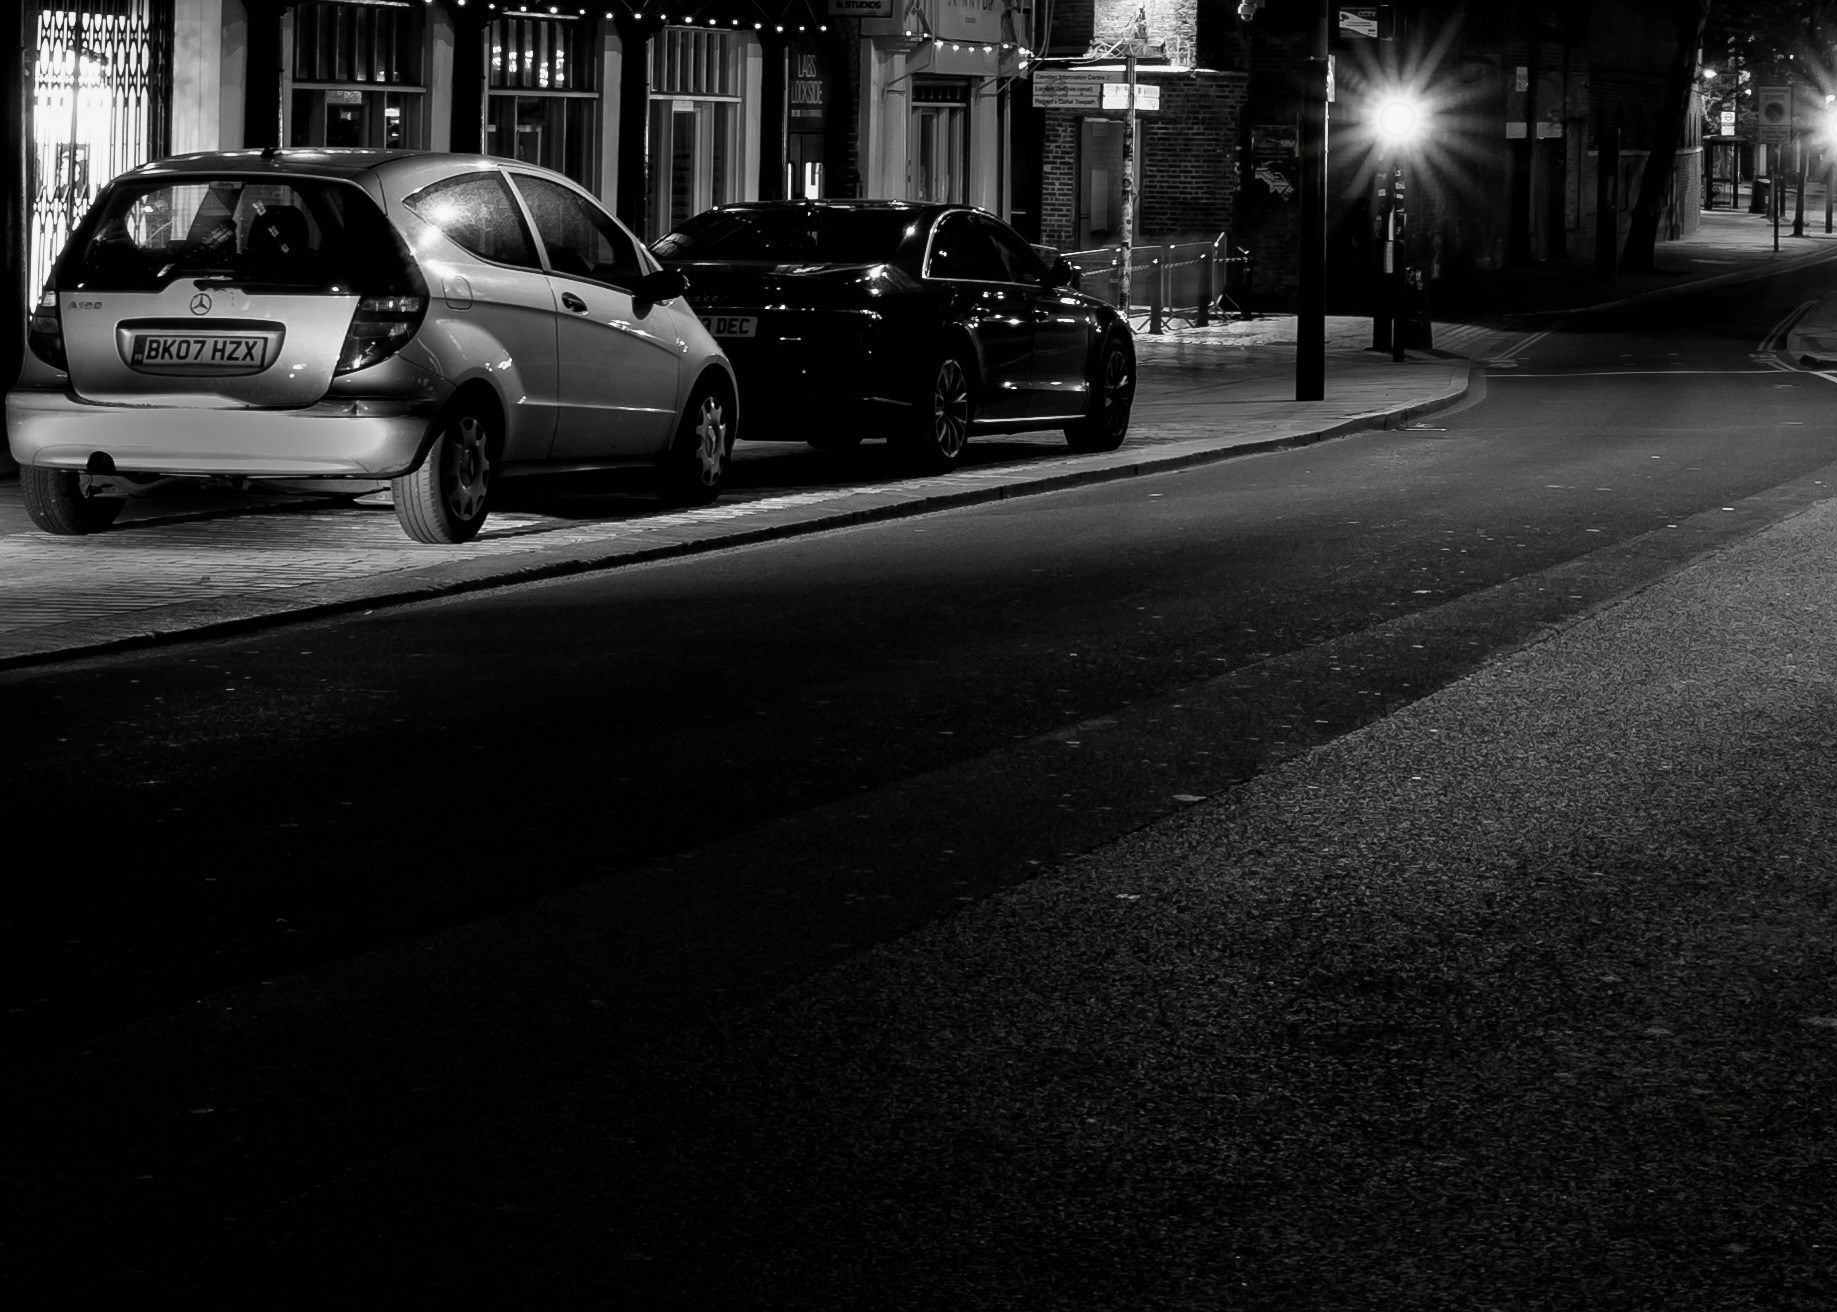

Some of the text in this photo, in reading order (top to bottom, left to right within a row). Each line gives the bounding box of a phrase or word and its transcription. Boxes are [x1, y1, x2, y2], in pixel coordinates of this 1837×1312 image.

[716, 318, 750, 334] DEC
[146, 339, 257, 361] BK07 HZX
